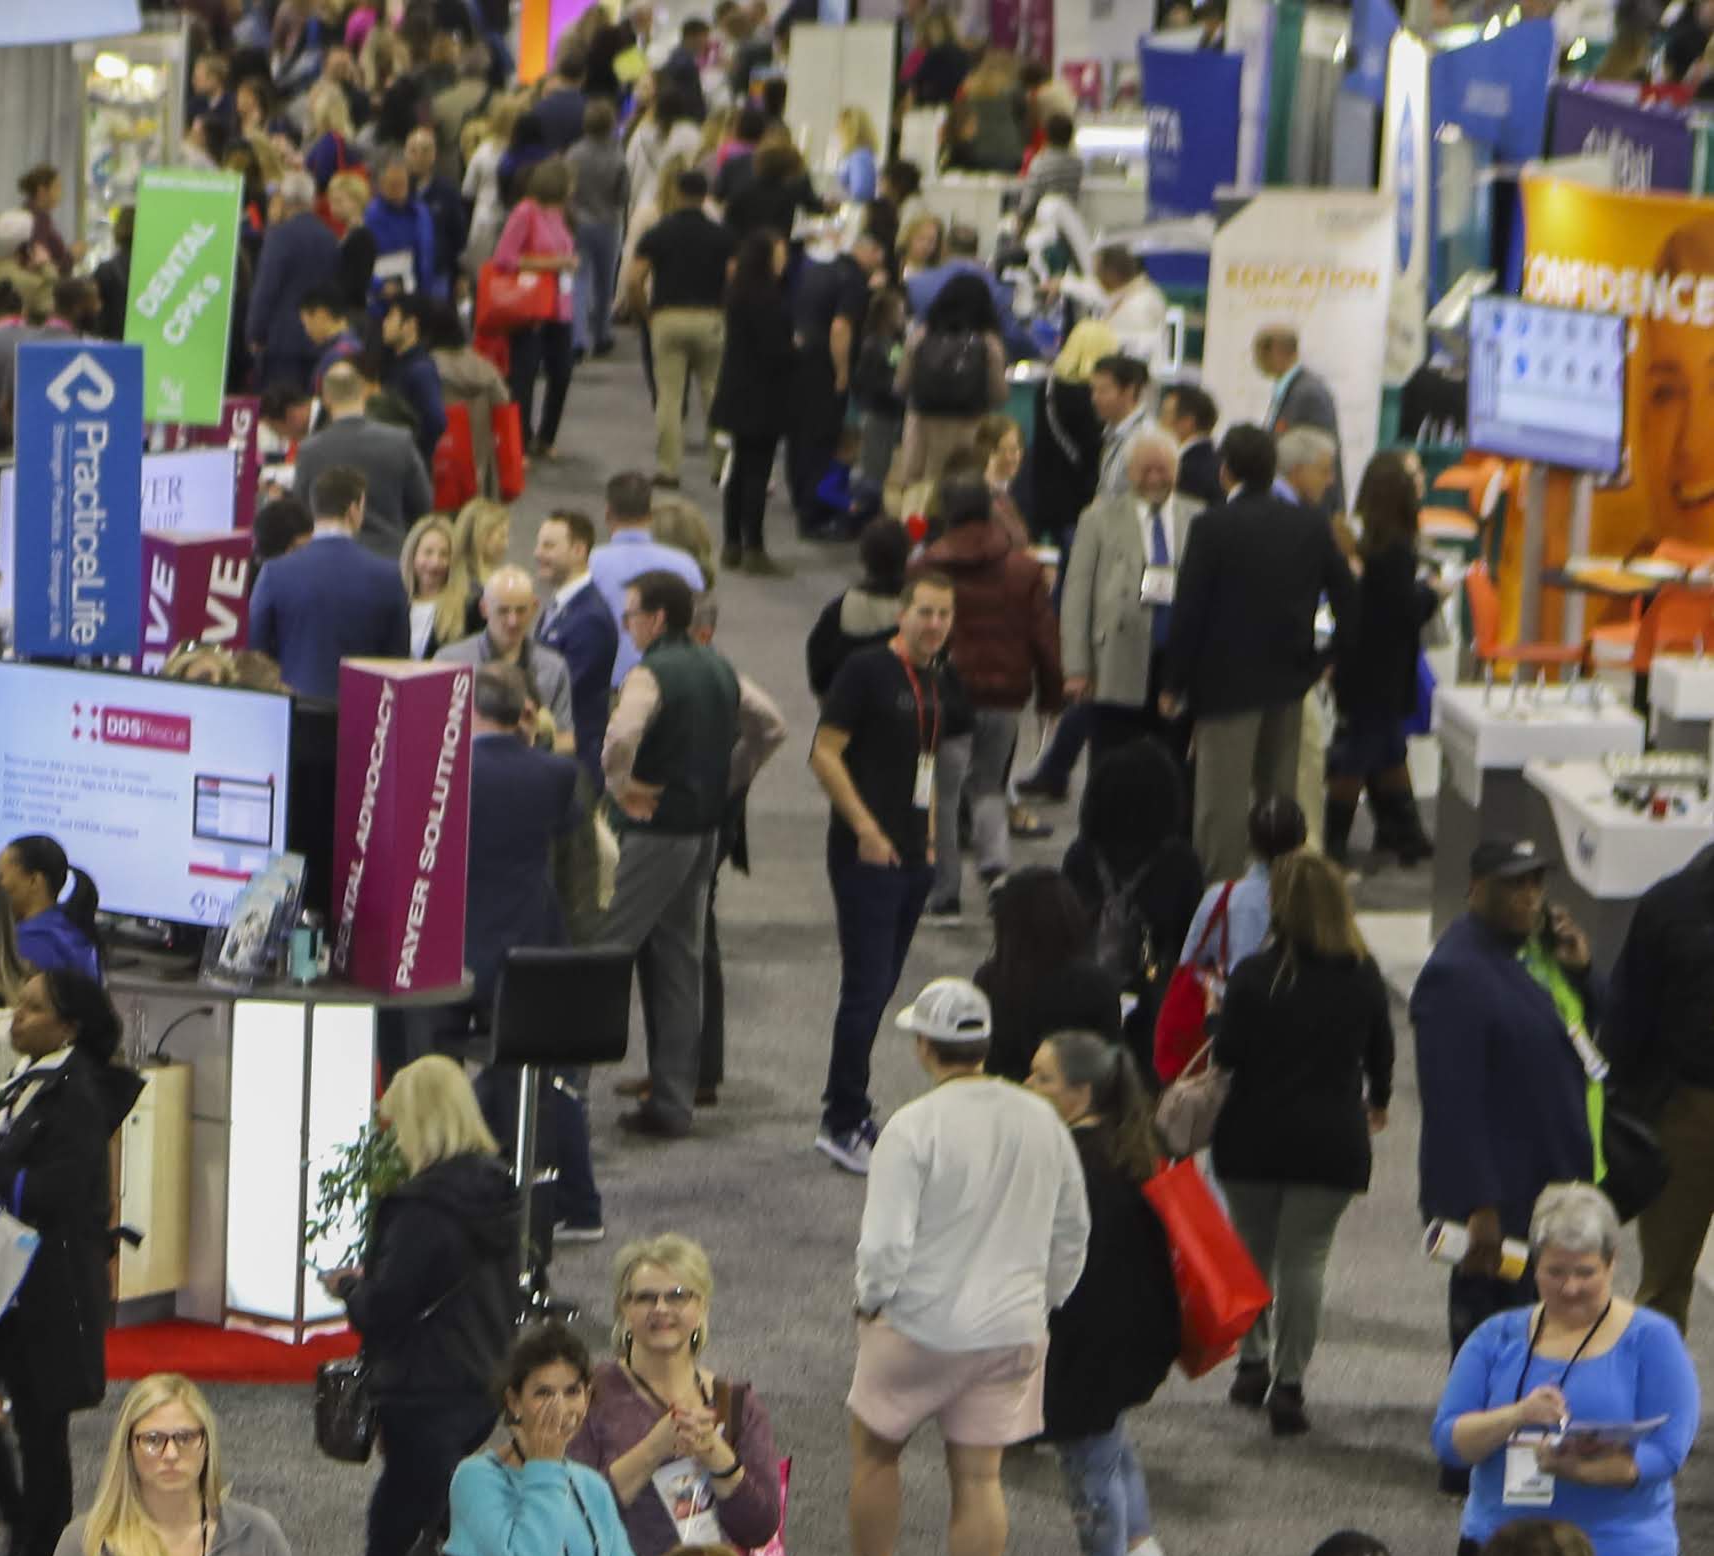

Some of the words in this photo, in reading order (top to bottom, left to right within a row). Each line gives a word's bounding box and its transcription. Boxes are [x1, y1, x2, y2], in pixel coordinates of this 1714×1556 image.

[136, 219, 217, 319] DENTAL
[1226, 265, 1380, 289] EDUCATION
[70, 421, 109, 646] PracticeLife
[333, 857, 364, 971] DENTAL
[356, 679, 394, 854] ADVOCACY
[396, 877, 430, 989] PAYER
[419, 670, 470, 873] SOLUTIONS
